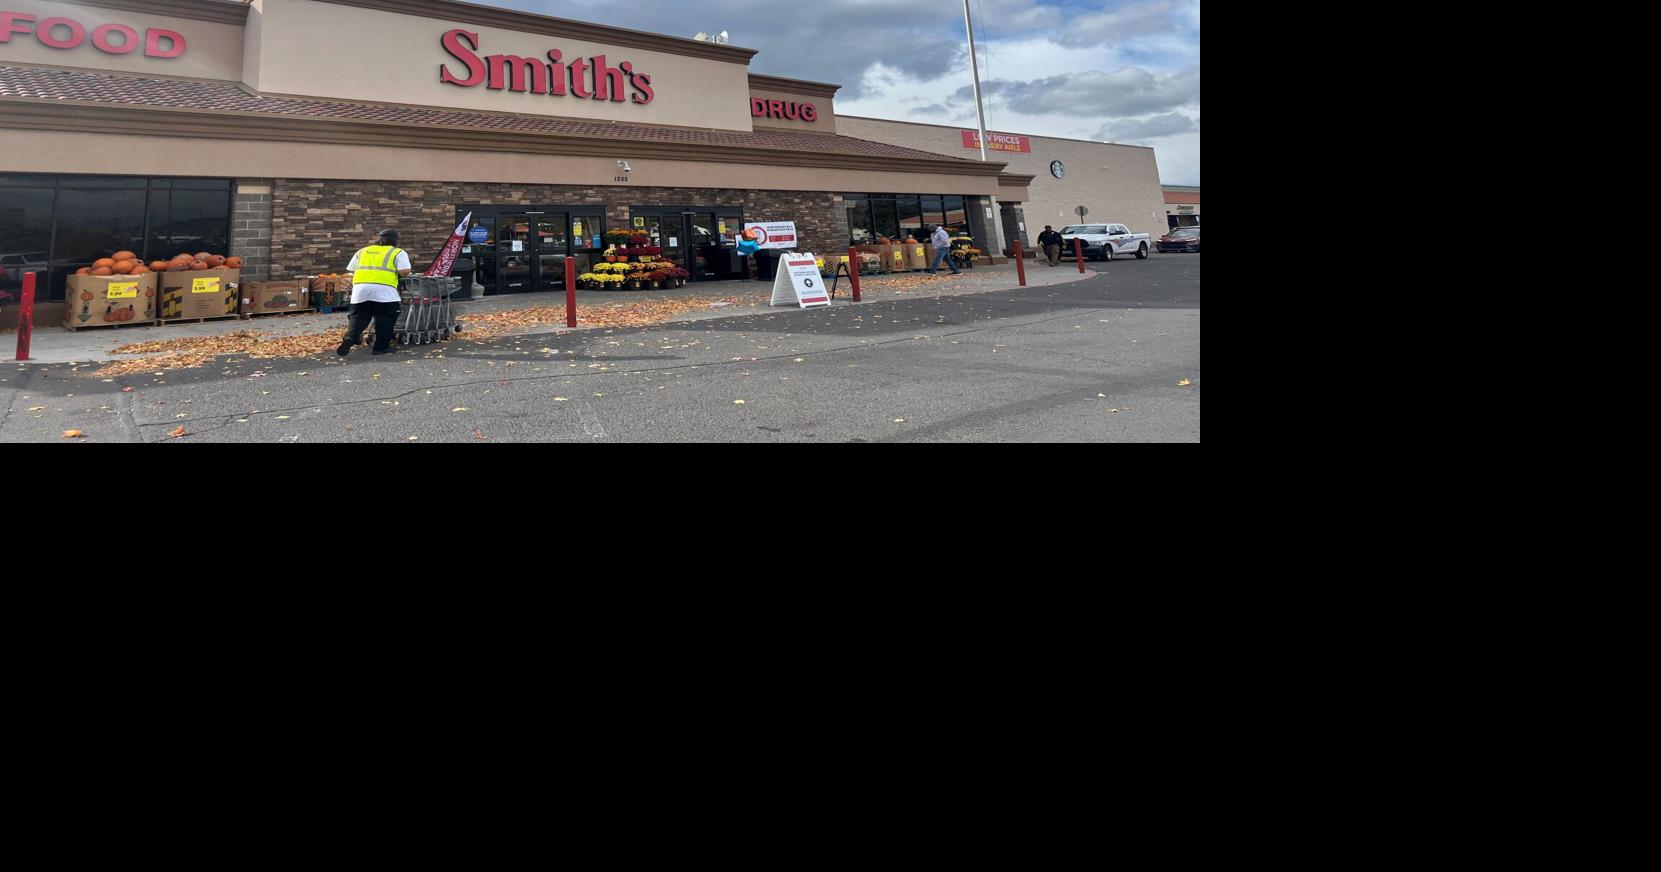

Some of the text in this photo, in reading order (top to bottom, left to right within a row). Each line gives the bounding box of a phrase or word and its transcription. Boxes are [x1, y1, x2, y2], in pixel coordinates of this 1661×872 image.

[0, 11, 186, 58] FOOD
[440, 28, 654, 104] Smith's
[750, 97, 817, 122] DRUG
[973, 132, 1020, 144] LW PRICES
[1006, 143, 1022, 151] AISLE
